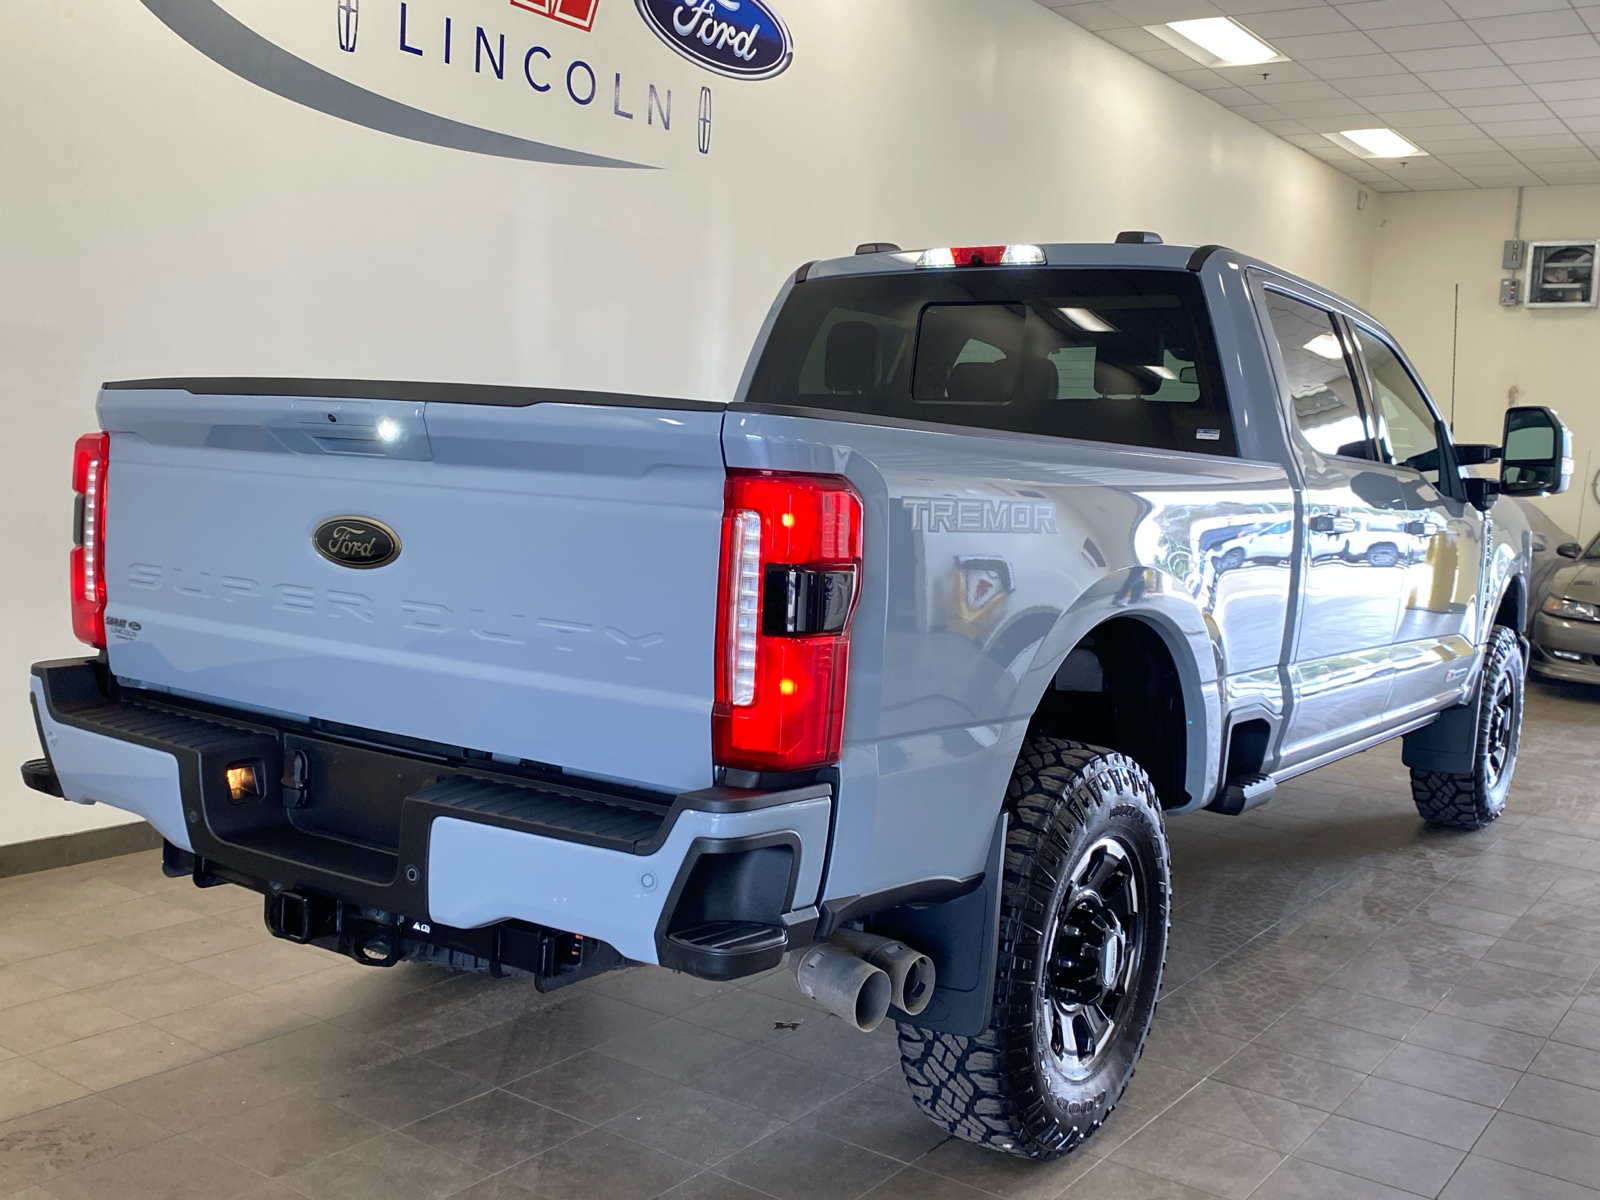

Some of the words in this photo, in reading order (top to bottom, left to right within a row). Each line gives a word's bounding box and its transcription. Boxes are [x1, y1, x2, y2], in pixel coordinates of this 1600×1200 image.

[672, 0, 760, 61] Ford
[400, 2, 671, 131] LINCOLN
[328, 525, 376, 557] Ford
[900, 495, 1058, 535] TREMOR
[128, 562, 373, 624] SUPER
[401, 599, 664, 662] DUTY
